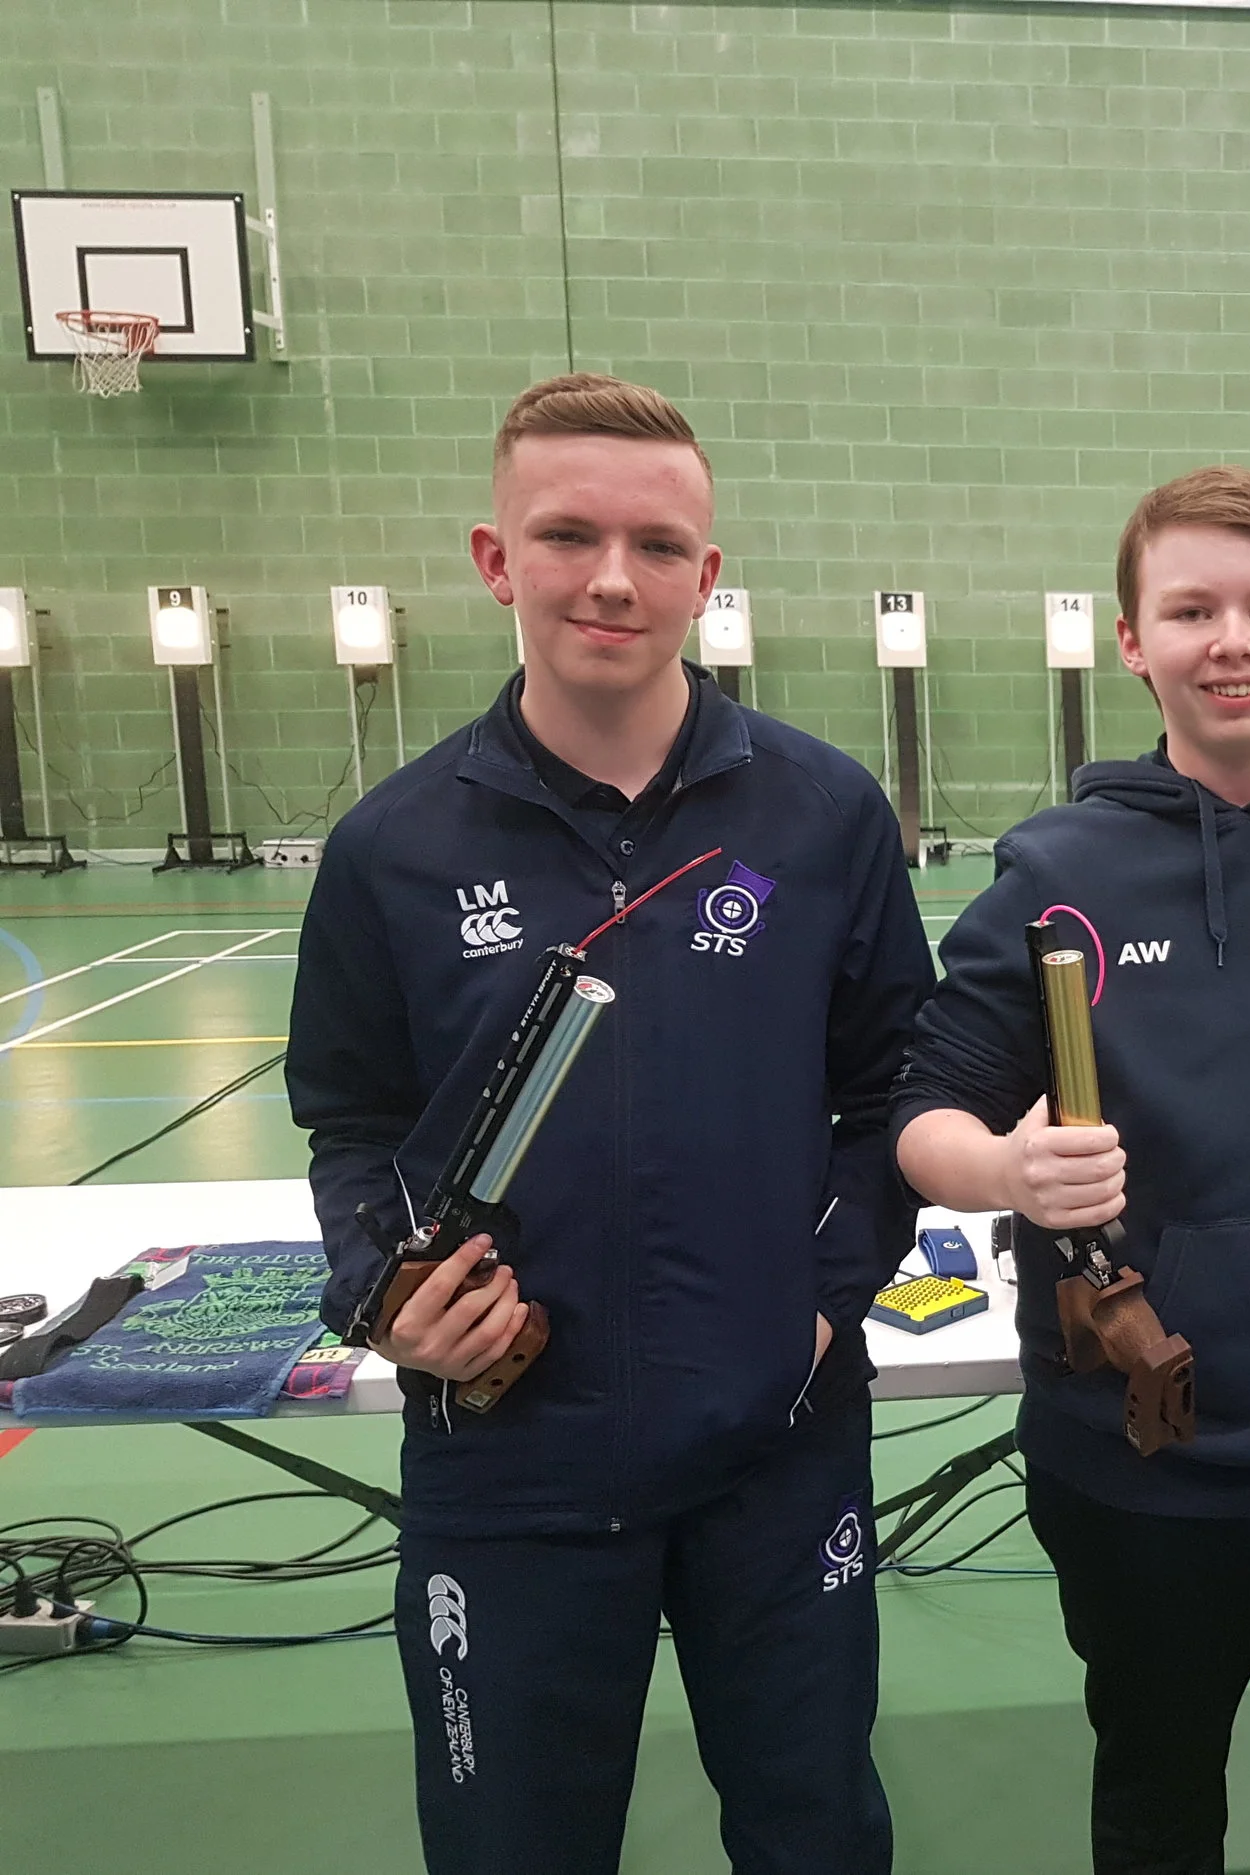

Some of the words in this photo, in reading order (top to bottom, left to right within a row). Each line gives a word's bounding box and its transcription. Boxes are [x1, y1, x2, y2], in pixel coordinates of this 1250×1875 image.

[169, 590, 181, 606] 9
[347, 591, 367, 606] 10
[714, 593, 736, 609] 12
[886, 595, 908, 612] 13
[1060, 598, 1080, 613] 14
[456, 880, 509, 911] LM
[462, 938, 524, 959] canterbury
[690, 931, 747, 957] STS
[1117, 940, 1171, 966] AW
[520, 993, 540, 1028] STEYR
[538, 959, 557, 994] SPORT
[189, 1253, 241, 1264] THE
[241, 1254, 291, 1264] OLD
[294, 1253, 328, 1264] CO
[131, 1337, 300, 1355] ANDREWS
[89, 1354, 240, 1372] Scotland
[823, 1554, 864, 1593] STS
[439, 1667, 453, 1691] OF
[441, 1688, 457, 1722] NEW
[455, 1687, 476, 1775] CANTERBURY
[445, 1721, 464, 1783] ZEALAND
